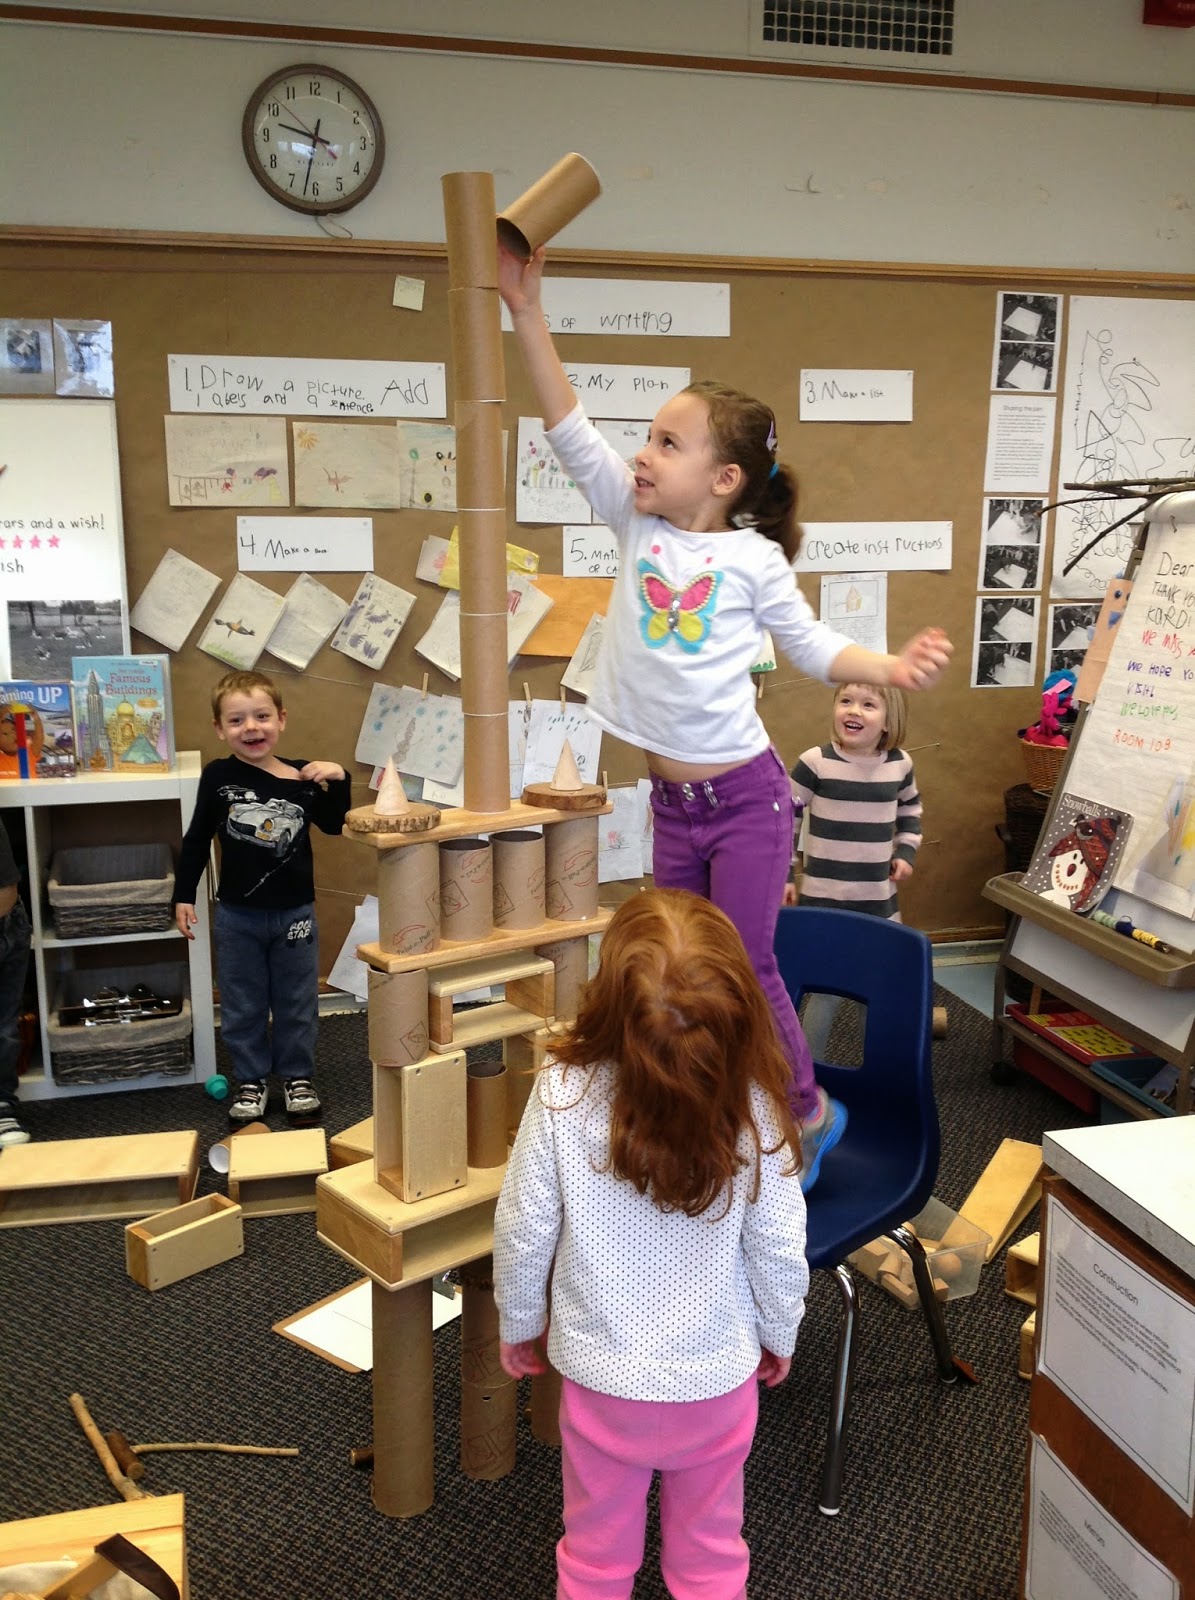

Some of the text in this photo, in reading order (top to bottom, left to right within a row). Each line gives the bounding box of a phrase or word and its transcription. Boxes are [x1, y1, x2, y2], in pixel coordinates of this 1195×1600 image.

[286, 86, 296, 100] 11
[309, 81, 321, 96] 12
[267, 103, 280, 117] 10
[352, 110, 360, 125] 2
[262, 128, 270, 142] 9
[360, 136, 367, 150] 3
[270, 154, 277, 168] 8
[353, 161, 360, 175] 4
[288, 173, 295, 188] 7
[336, 177, 343, 191] 5
[312, 182, 319, 196] 6
[600, 312, 673, 333] writing
[284, 380, 294, 391] a
[380, 378, 429, 406] Add
[263, 393, 286, 405] and
[307, 394, 318, 408] a
[0, 513, 104, 530] ars and a wish!
[0, 558, 24, 573] ish
[606, 566, 618, 575] CA
[1157, 551, 1194, 576] Dear
[110, 673, 151, 684] Famous
[37, 686, 63, 704] UP
[105, 683, 158, 697] Buildings
[1063, 794, 1102, 818] Snowballs
[1093, 1263, 1139, 1306] Construction
